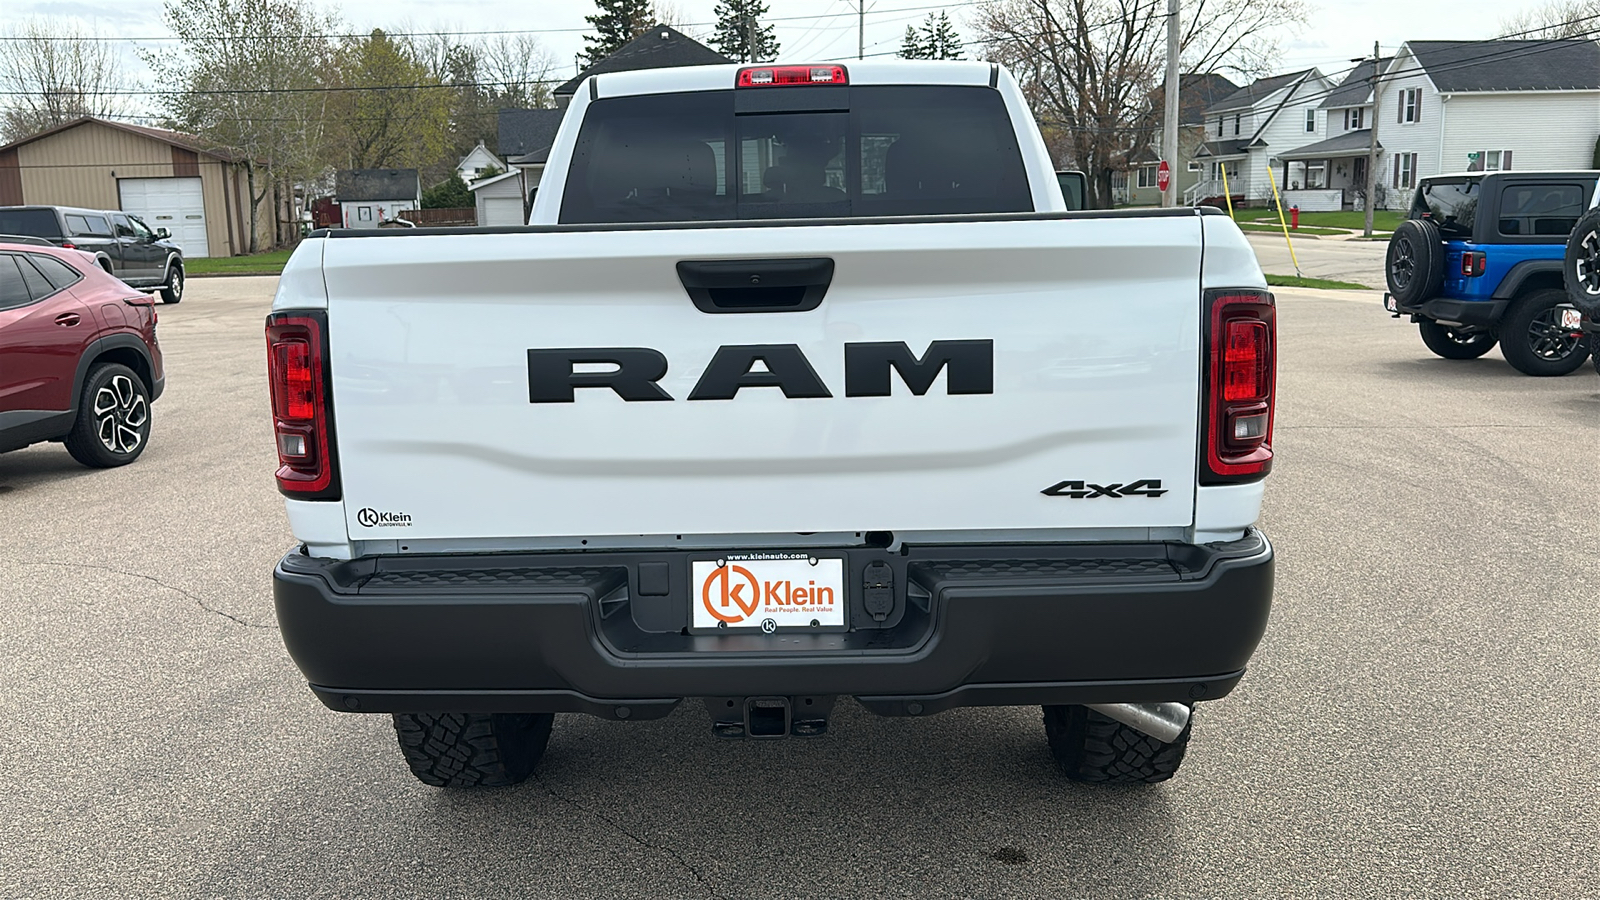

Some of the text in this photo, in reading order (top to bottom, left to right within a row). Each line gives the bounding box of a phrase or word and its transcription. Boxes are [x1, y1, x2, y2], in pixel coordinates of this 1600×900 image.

[1158, 170, 1169, 182] STOP
[527, 338, 994, 404] RAM
[1040, 479, 1169, 498] 4x4
[380, 512, 412, 522] Klein
[764, 580, 834, 605] Klein
